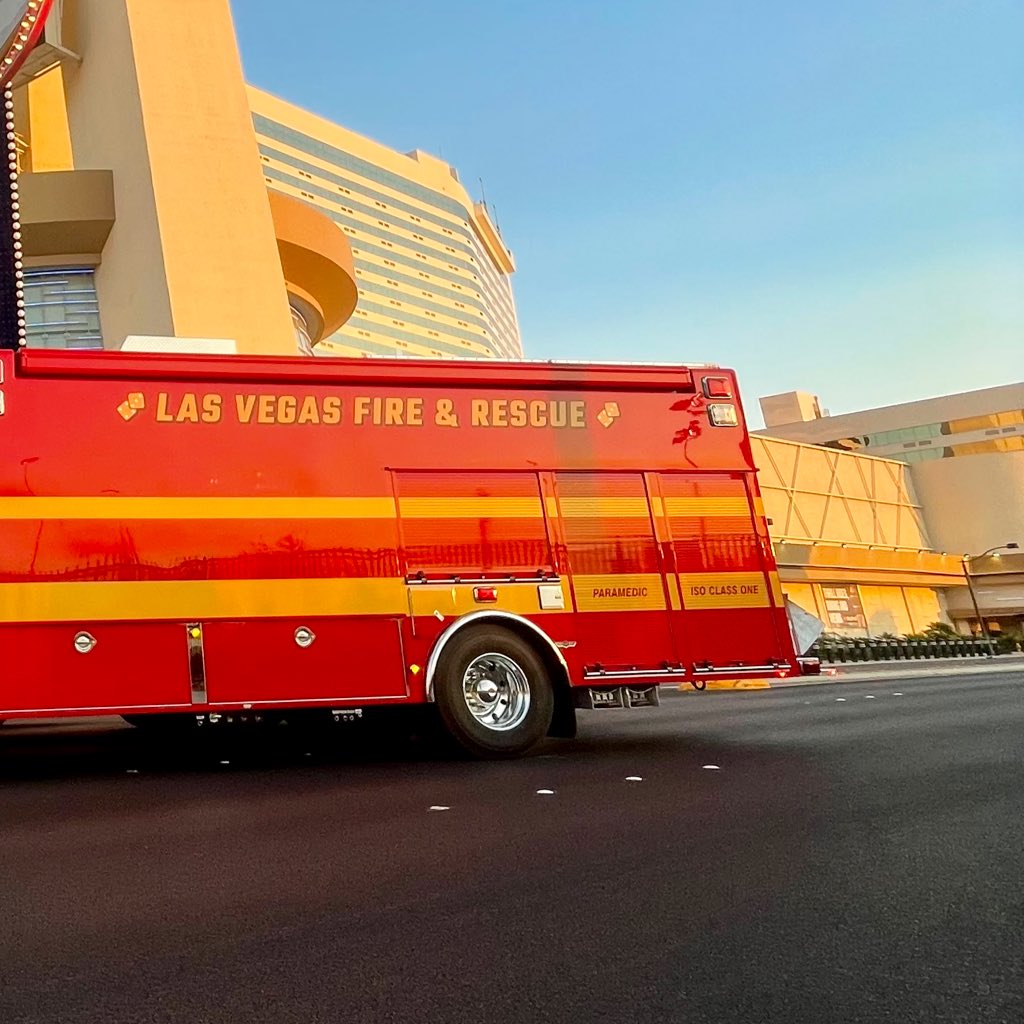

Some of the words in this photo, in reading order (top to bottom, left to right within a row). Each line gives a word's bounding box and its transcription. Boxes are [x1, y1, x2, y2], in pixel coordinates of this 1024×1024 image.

[156, 392, 223, 423] LAS
[235, 394, 343, 425] VEGAS
[353, 396, 424, 426] FIRE
[434, 398, 460, 427] &
[470, 399, 586, 428] RESCUE
[592, 587, 648, 598] PARAMEDIC
[690, 586, 706, 596] ISO
[708, 585, 738, 596] CLASS
[740, 584, 759, 595] ONE
